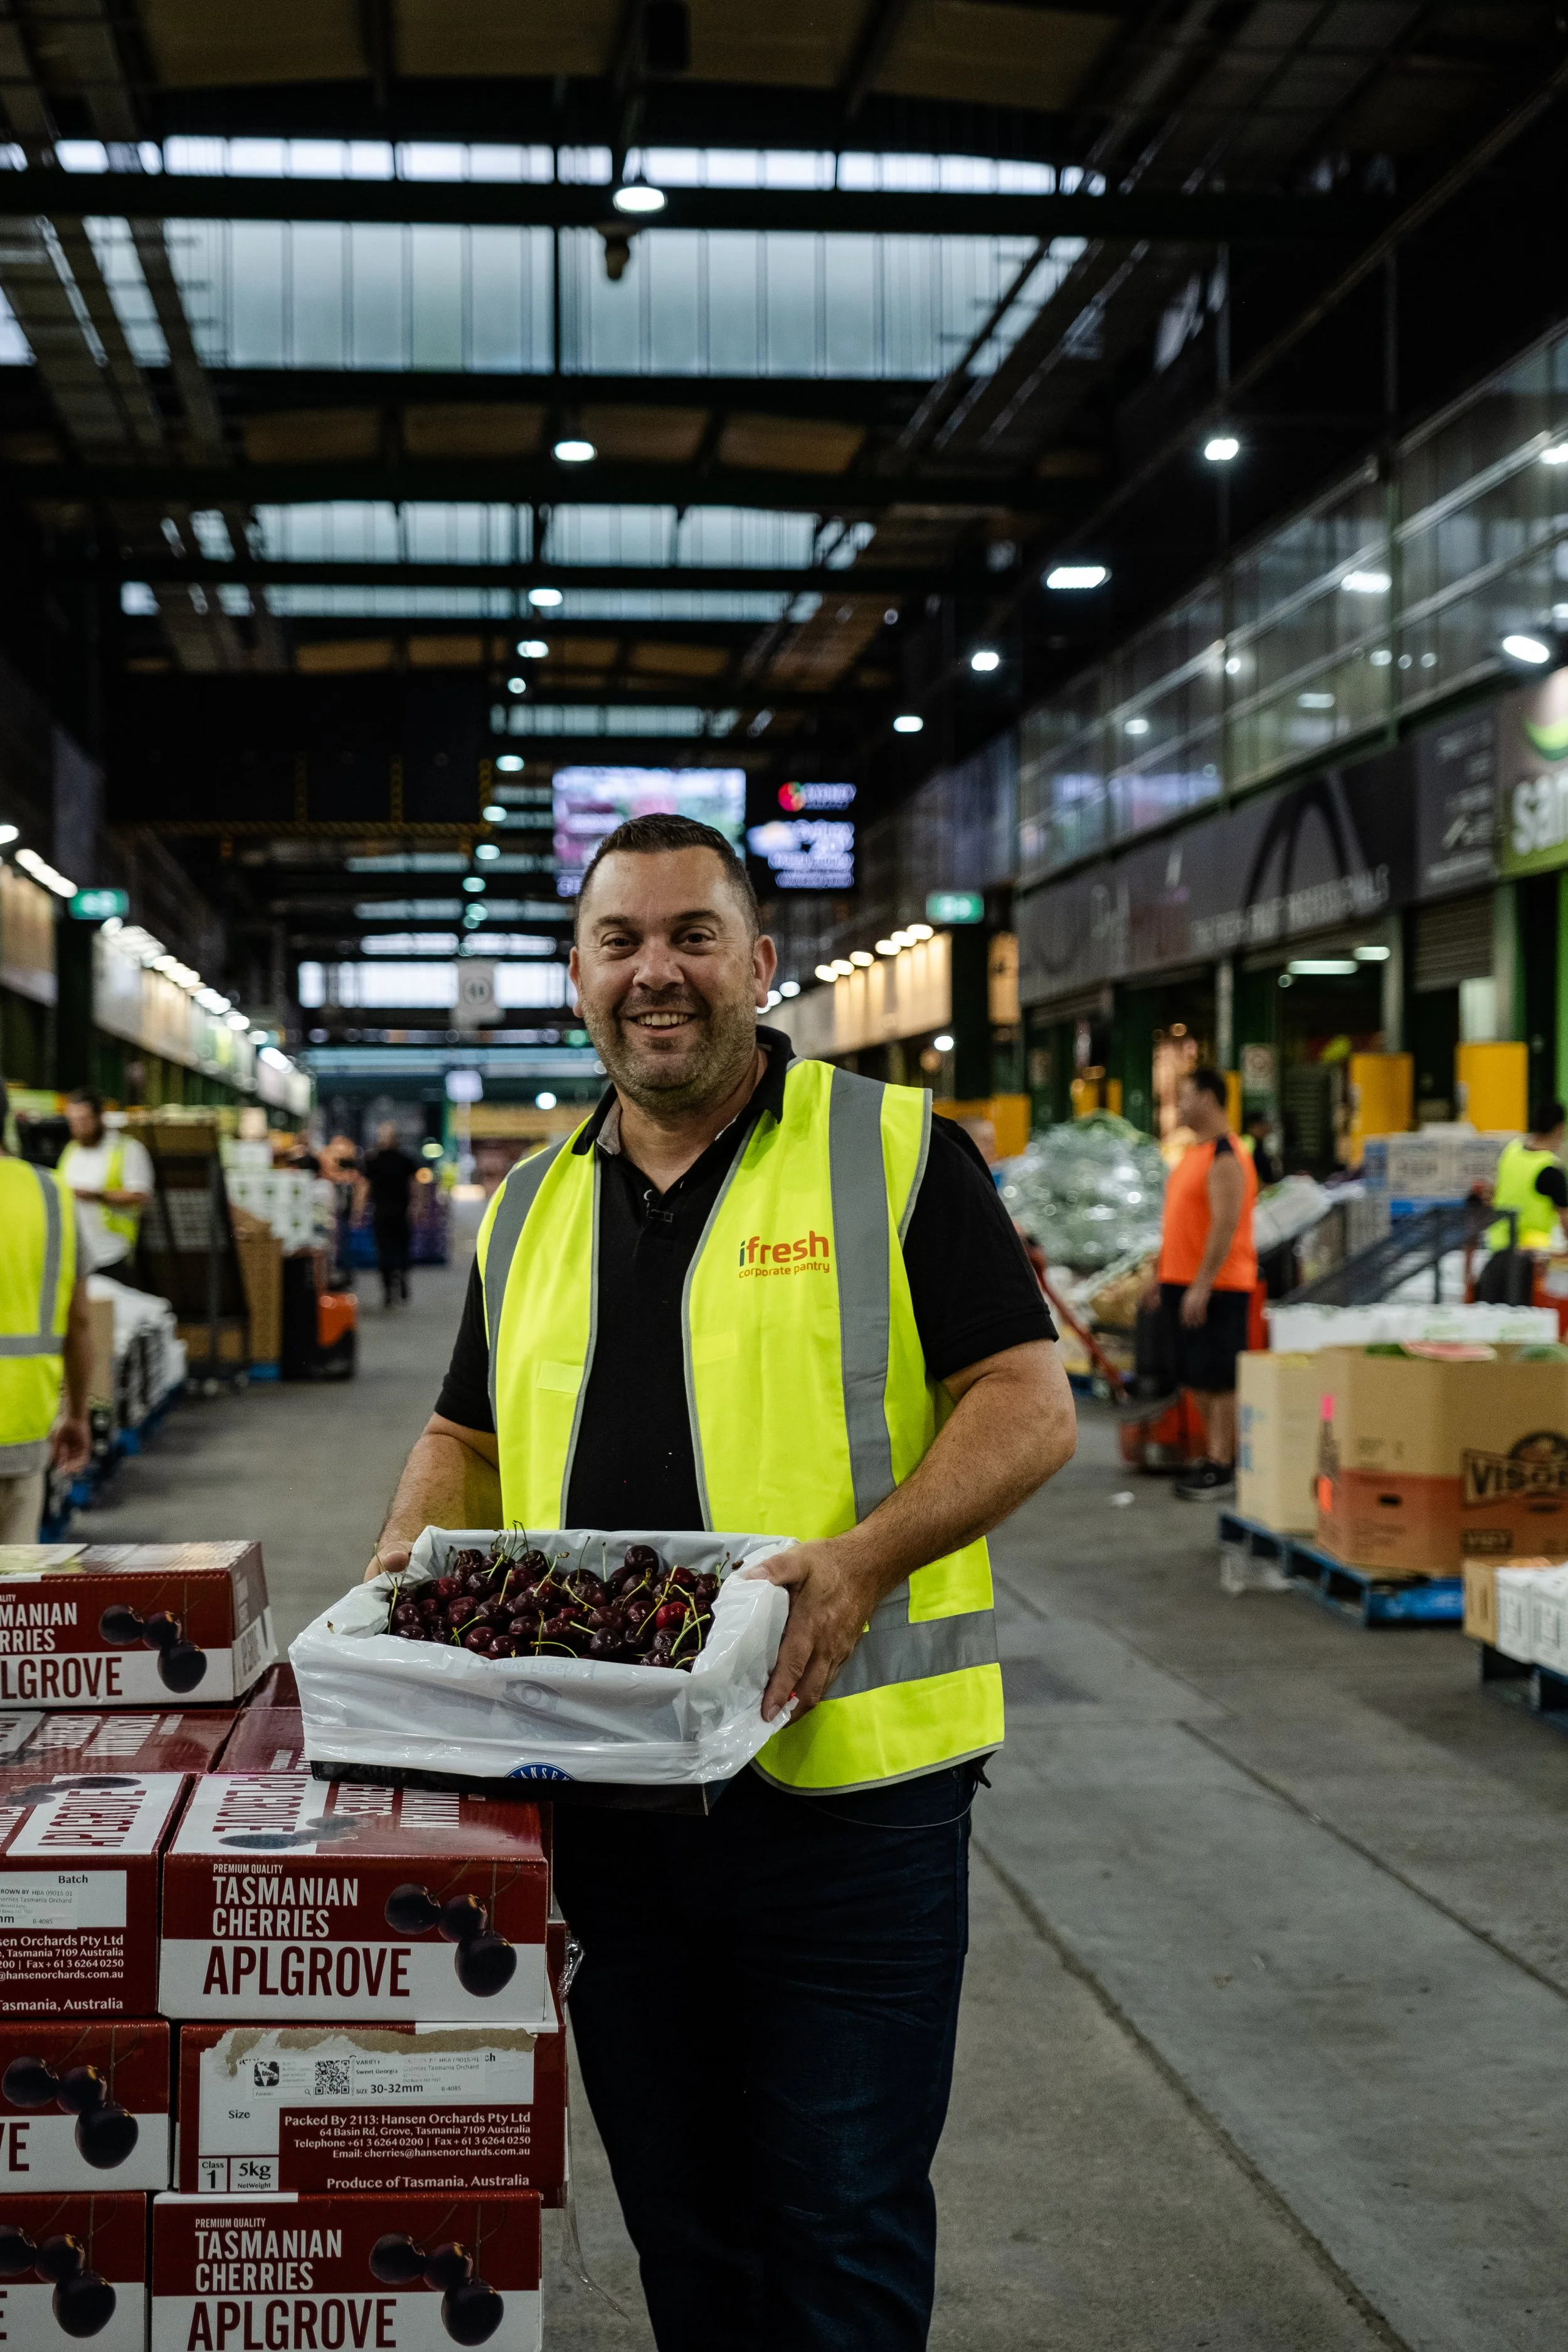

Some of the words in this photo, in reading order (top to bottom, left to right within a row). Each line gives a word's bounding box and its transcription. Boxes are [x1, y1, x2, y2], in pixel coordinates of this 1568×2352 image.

[739, 1231, 829, 1266] ifresh
[739, 1266, 791, 1278] corporate
[794, 1261, 830, 1275] pantry
[0, 1602, 77, 1627] MANIAN
[0, 1629, 55, 1653] RRIES
[1, 1657, 122, 1699] LGROVE
[510, 1767, 569, 1781] ANSE
[212, 1776, 308, 1831] APLGROVE
[400, 1788, 459, 1828] MANIAN
[37, 1790, 147, 1846] APLGROVE
[213, 1863, 249, 1873] PREMIUM
[252, 1864, 283, 1874] QUALITY
[58, 1874, 88, 1884] Batch
[213, 1876, 358, 1906] TASMANIAN
[213, 1908, 329, 1938] CHERRIES
[21, 1935, 77, 1946] Orchards
[80, 1935, 101, 1947] Pty
[104, 1934, 124, 1945] Ltd
[7, 1949, 53, 1957] Tasmania
[56, 1949, 78, 1957] 7109
[80, 1947, 124, 1956] Australia
[27, 1960, 44, 1968] Fax
[53, 1960, 63, 1968] 61
[67, 1959, 72, 1968] 3
[75, 1959, 98, 1968] 6264
[203, 1946, 411, 1997] APLGROVE
[0, 1998, 61, 2011] asmania,
[63, 1997, 124, 2010] Australia
[370, 2084, 424, 2094] 30-32mm
[228, 2110, 250, 2119] Size
[285, 2114, 328, 2126] Packed
[331, 2116, 347, 2127] By
[351, 2116, 379, 2125] 2113:
[381, 2114, 426, 2124] Hansen
[429, 2112, 485, 2124] Orchards
[488, 2112, 509, 2126] Pty
[511, 2112, 531, 2122] Ltd
[334, 2127, 360, 2136] Basin
[363, 2127, 378, 2137] Rd,
[380, 2127, 413, 2137] Grove,
[415, 2126, 460, 2135] Tasmania
[464, 2126, 485, 2134] 7109
[487, 2125, 531, 2134] Australia
[0, 2122, 29, 2171] E
[294, 2139, 345, 2149] Telephone
[347, 2139, 363, 2147] +61
[400, 2137, 423, 2146] 0200
[435, 2137, 452, 2146] Fax
[462, 2137, 472, 2145] 61
[475, 2137, 480, 2145] 3
[482, 2137, 506, 2145] 6264
[507, 2136, 531, 2144] 0250
[333, 2150, 363, 2158] Email:
[364, 2148, 531, 2159] cherries@hansenorchards.com.au
[206, 2170, 216, 2189] 1
[238, 2161, 271, 2180] 5kg
[327, 2178, 383, 2188] Produce
[386, 2176, 400, 2188] of
[402, 2175, 469, 2188] Tasmania,
[470, 2174, 529, 2186] Australia
[195, 2218, 231, 2228] PREMIUM
[233, 2218, 266, 2228] QUALITY
[195, 2229, 341, 2260] TASMANIAN
[195, 2262, 314, 2292] CHERRIES
[187, 2299, 396, 2352] APLGROVE
